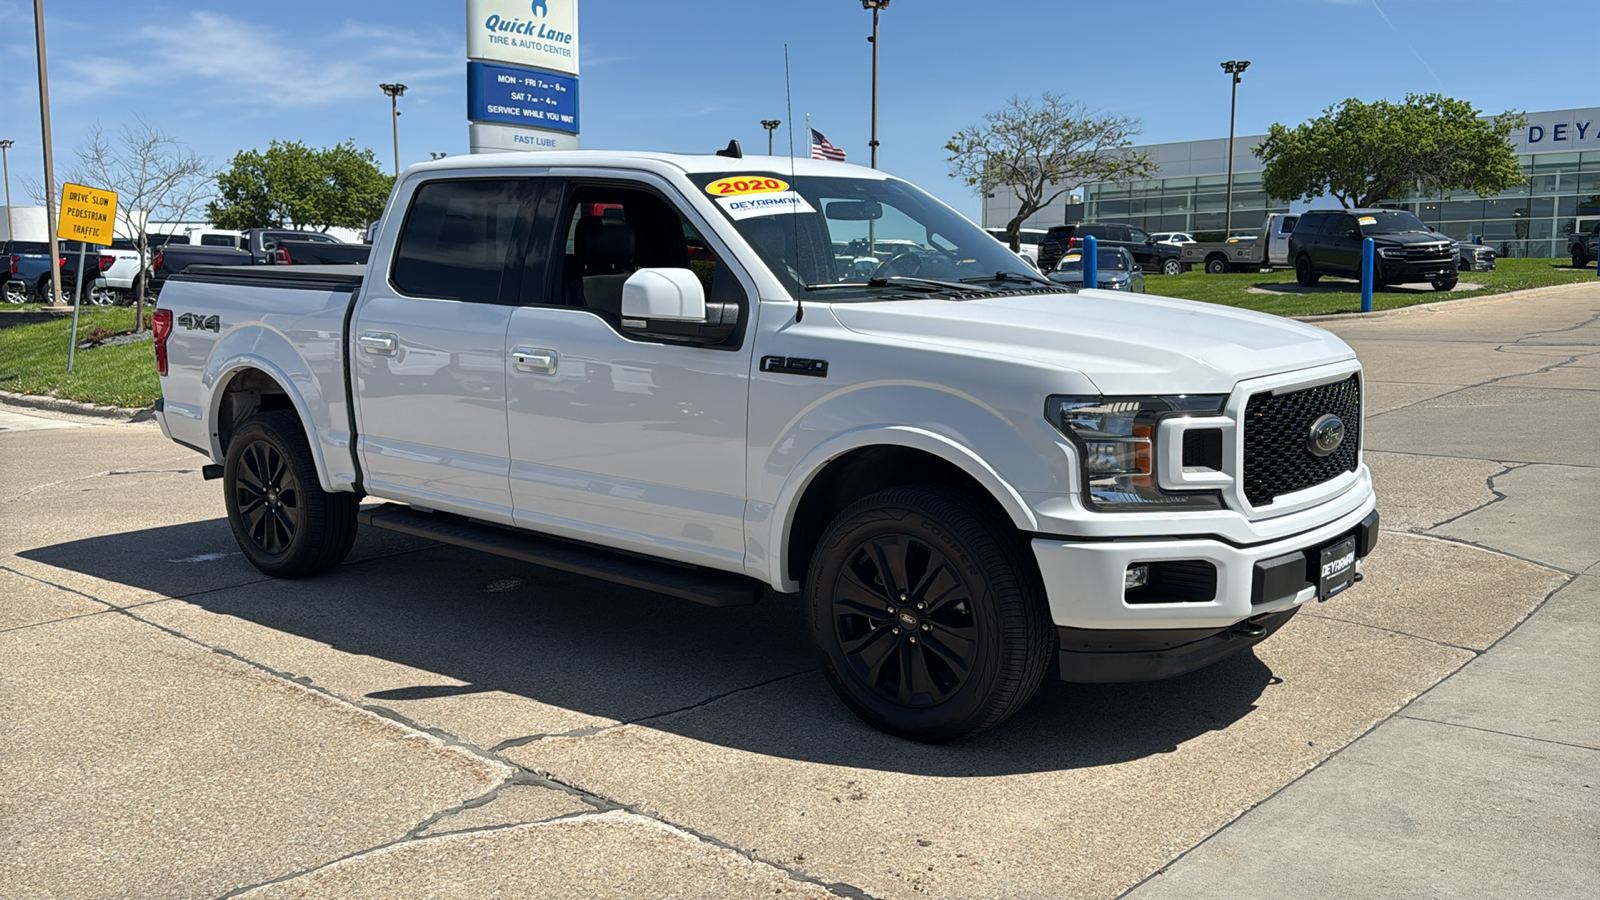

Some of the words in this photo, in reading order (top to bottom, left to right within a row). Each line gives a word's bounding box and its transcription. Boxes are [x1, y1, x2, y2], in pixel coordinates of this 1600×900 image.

[485, 14, 536, 36] Quick
[537, 23, 573, 44] Lane
[488, 35, 510, 46] TIRE
[511, 38, 518, 47] &
[519, 40, 542, 51] AUTO
[543, 44, 572, 58] CENTER
[497, 75, 517, 84] MON
[525, 78, 537, 87] FRI
[511, 92, 525, 101] SAT
[487, 105, 521, 116] SERVICE
[522, 108, 545, 119] WHILE
[546, 111, 560, 121] YOU
[561, 114, 574, 124] WAIT
[1528, 121, 1600, 144] DEY
[514, 135, 535, 145] FAST
[536, 137, 557, 148] LUBE
[716, 179, 781, 194] 2020
[69, 191, 89, 204] DRIVE
[92, 195, 110, 206] SLOW
[729, 197, 800, 210] DEYARMAN
[67, 207, 108, 222] PEDESTRIAN
[73, 224, 101, 237] TRAFFIC
[921, 521, 977, 576] COOPER
[1321, 551, 1355, 578] DEYARMAN
